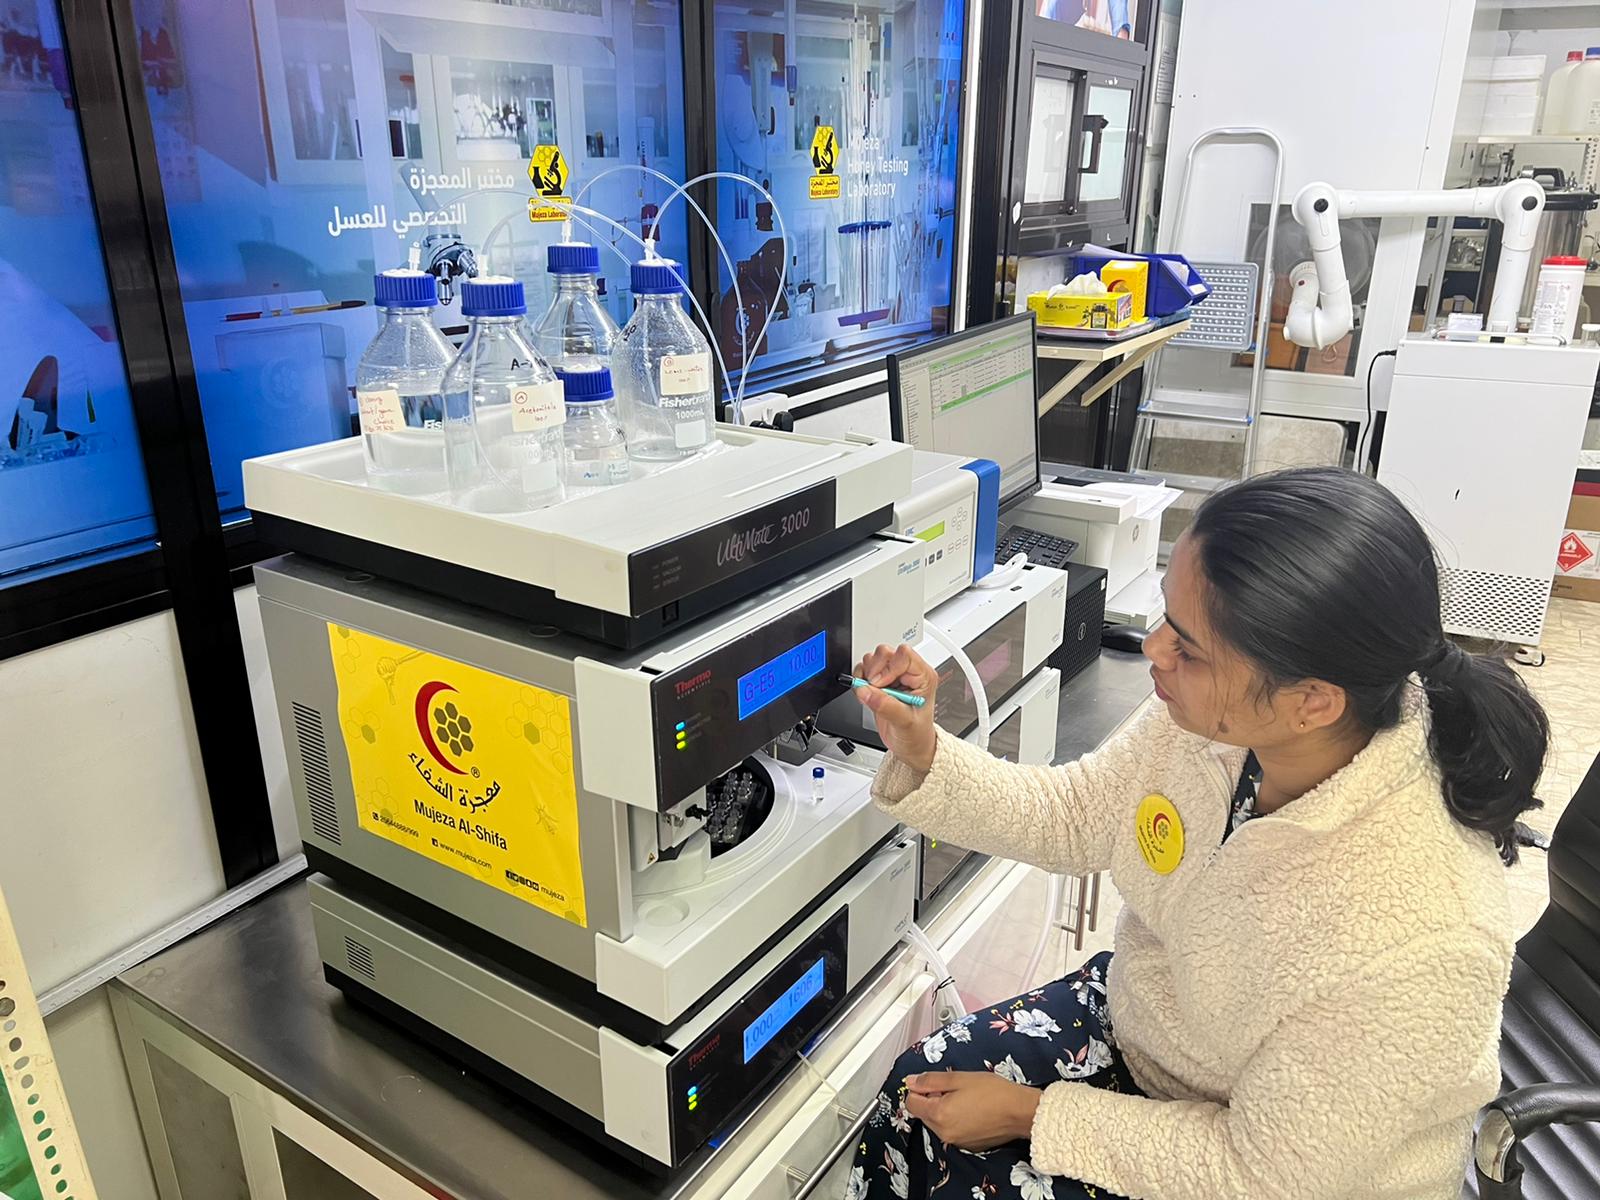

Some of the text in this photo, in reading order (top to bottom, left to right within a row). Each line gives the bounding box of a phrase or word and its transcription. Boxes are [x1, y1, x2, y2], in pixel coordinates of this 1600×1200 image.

[848, 156, 909, 177] Honey Testing
[409, 167, 514, 196] مختبر المعجزة
[848, 179, 896, 199] Laboratory
[327, 203, 468, 239] التخصصي للعسل
[717, 507, 810, 567] UltiMate 3000
[674, 669, 711, 694] Thermo
[744, 644, 817, 702] G-E5 10.00
[413, 799, 456, 829] Mujeza
[458, 817, 508, 850] Al-Shifa
[439, 843, 493, 870] www.mujeza.com
[540, 885, 565, 902] mujeza
[745, 1013, 773, 1049] 1.000
